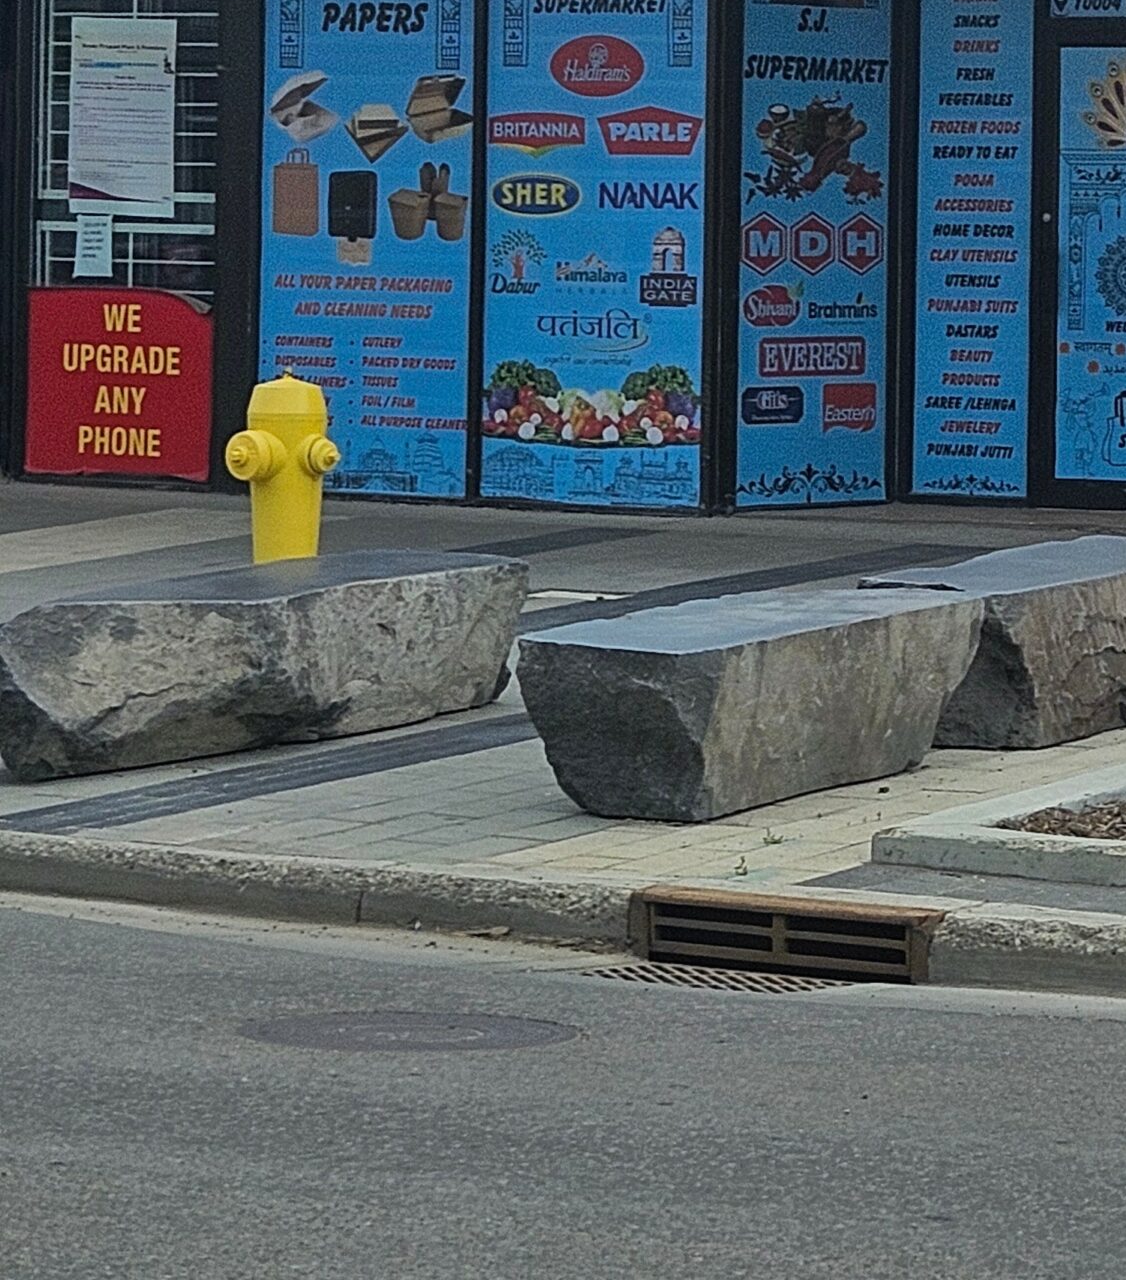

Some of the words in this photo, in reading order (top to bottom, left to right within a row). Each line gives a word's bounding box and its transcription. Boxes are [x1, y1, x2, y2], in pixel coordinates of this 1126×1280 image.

[321, 2, 429, 35] PAPERS
[797, 8, 829, 33] S.J.
[952, 14, 1001, 28] SNACKS
[952, 39, 1001, 53] DRINKS
[563, 58, 631, 82] Haldiram's
[744, 54, 889, 84] SUPERMARKET
[955, 67, 995, 82] FRESH
[938, 93, 1013, 108] VEGETABLES
[493, 121, 580, 139] BRITANNIA
[609, 121, 693, 143] PARLE
[929, 120, 978, 135] FROZEN
[979, 120, 1021, 135] FOODS
[932, 145, 974, 160] READY
[976, 146, 992, 160] TO
[994, 146, 1019, 160] EAT
[953, 173, 995, 187] POOJA
[501, 181, 567, 205] SHER
[599, 181, 700, 210] NANAK
[934, 198, 1014, 213] ACCESSORIES
[932, 223, 970, 238] HOME
[972, 224, 1014, 239] DECOR
[929, 249, 961, 263] CLAY
[962, 249, 1019, 263] UTENSILS
[556, 261, 628, 283] Himalaya
[274, 274, 295, 289] ALL
[300, 275, 332, 290] YOUR
[335, 276, 376, 291] PAPER
[379, 277, 453, 293] PACKAGING
[488, 273, 540, 295] Dabur
[643, 278, 694, 290] INDIA
[945, 274, 1001, 288] UTENSILS
[643, 290, 693, 302] GATE
[295, 302, 321, 316] AND
[324, 303, 387, 317] CLEANING
[390, 304, 433, 319] NEEDS
[808, 292, 878, 319] Brahmins
[927, 299, 982, 314] PUNJABI
[985, 300, 1019, 314] SUITS
[103, 303, 142, 333] WE
[536, 307, 641, 340] पतंजलि
[945, 325, 999, 339] DASTARS
[275, 335, 334, 348] CONTAINERS
[362, 337, 403, 348] CUTLERY
[62, 344, 181, 376] UPGRADE
[275, 355, 337, 368] DISPOSABLES
[361, 356, 399, 368] PACKED
[401, 357, 422, 369] DRY
[423, 358, 456, 370] GOODS
[763, 342, 862, 373] EVEREST
[950, 350, 994, 363] BEAUTY
[362, 376, 398, 388] TISSUES
[941, 373, 1001, 387] PRODUCTS
[94, 386, 147, 416] ANY
[361, 396, 382, 407] FOIL
[391, 397, 416, 408] FILM
[925, 396, 963, 411] SAREE
[824, 404, 876, 422] Eastern
[361, 415, 379, 427] ALL
[380, 417, 423, 429] PURPOSE
[940, 420, 1001, 435] JEWELERY
[78, 426, 161, 458] PHONE
[927, 444, 979, 459] PUNJABI
[981, 445, 1014, 459] JUTTI
